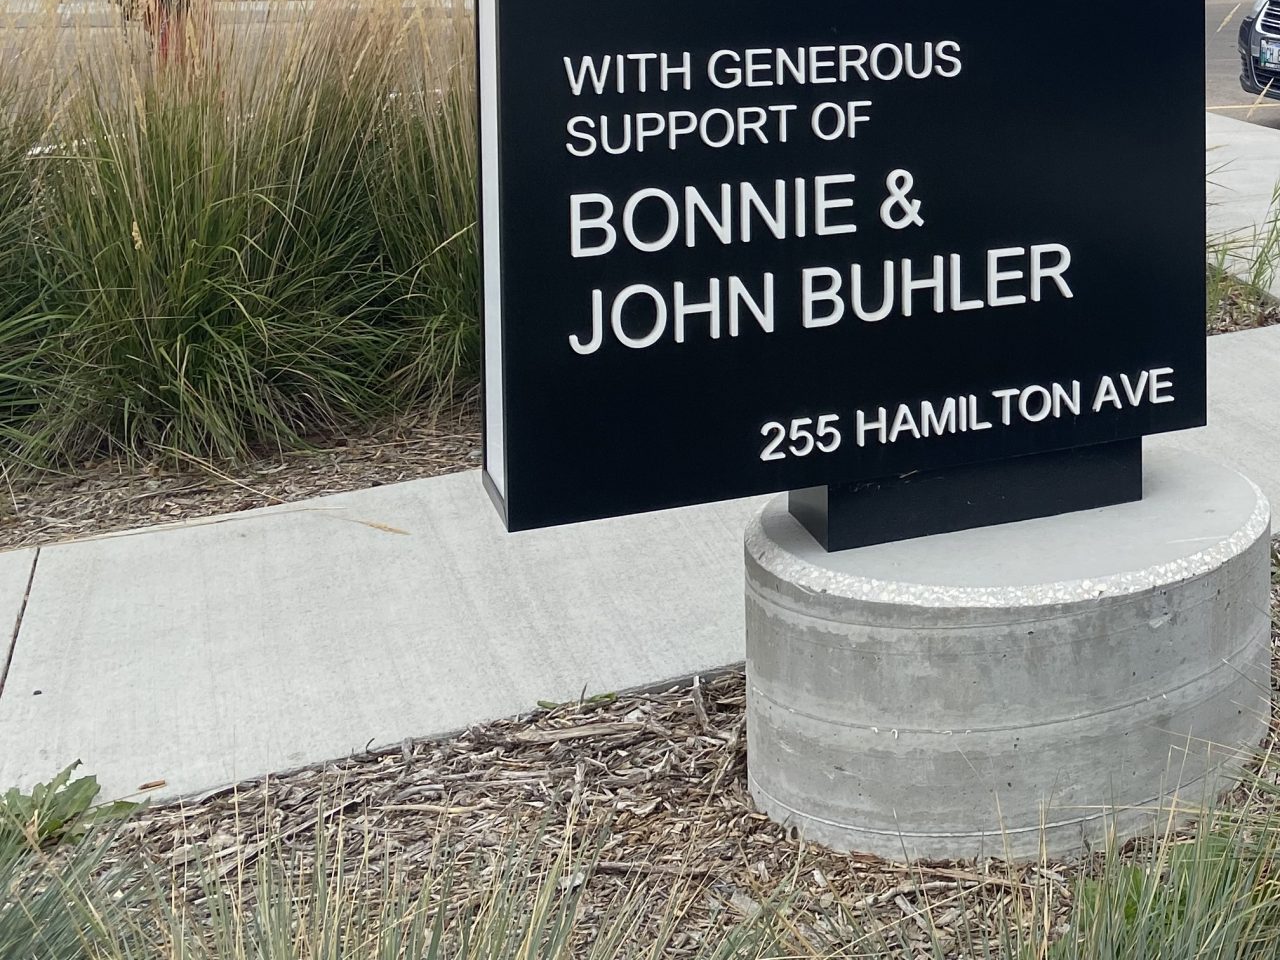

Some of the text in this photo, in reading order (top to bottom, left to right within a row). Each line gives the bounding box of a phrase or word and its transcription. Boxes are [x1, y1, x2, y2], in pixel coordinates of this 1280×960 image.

[562, 40, 963, 96] WITH GENEROUS
[564, 100, 874, 157] SUPPORT OF
[569, 168, 926, 259] BONNIE &
[567, 243, 1075, 356] JOHN BUHLER
[759, 366, 1176, 463] 255 HAMILTON AVE
